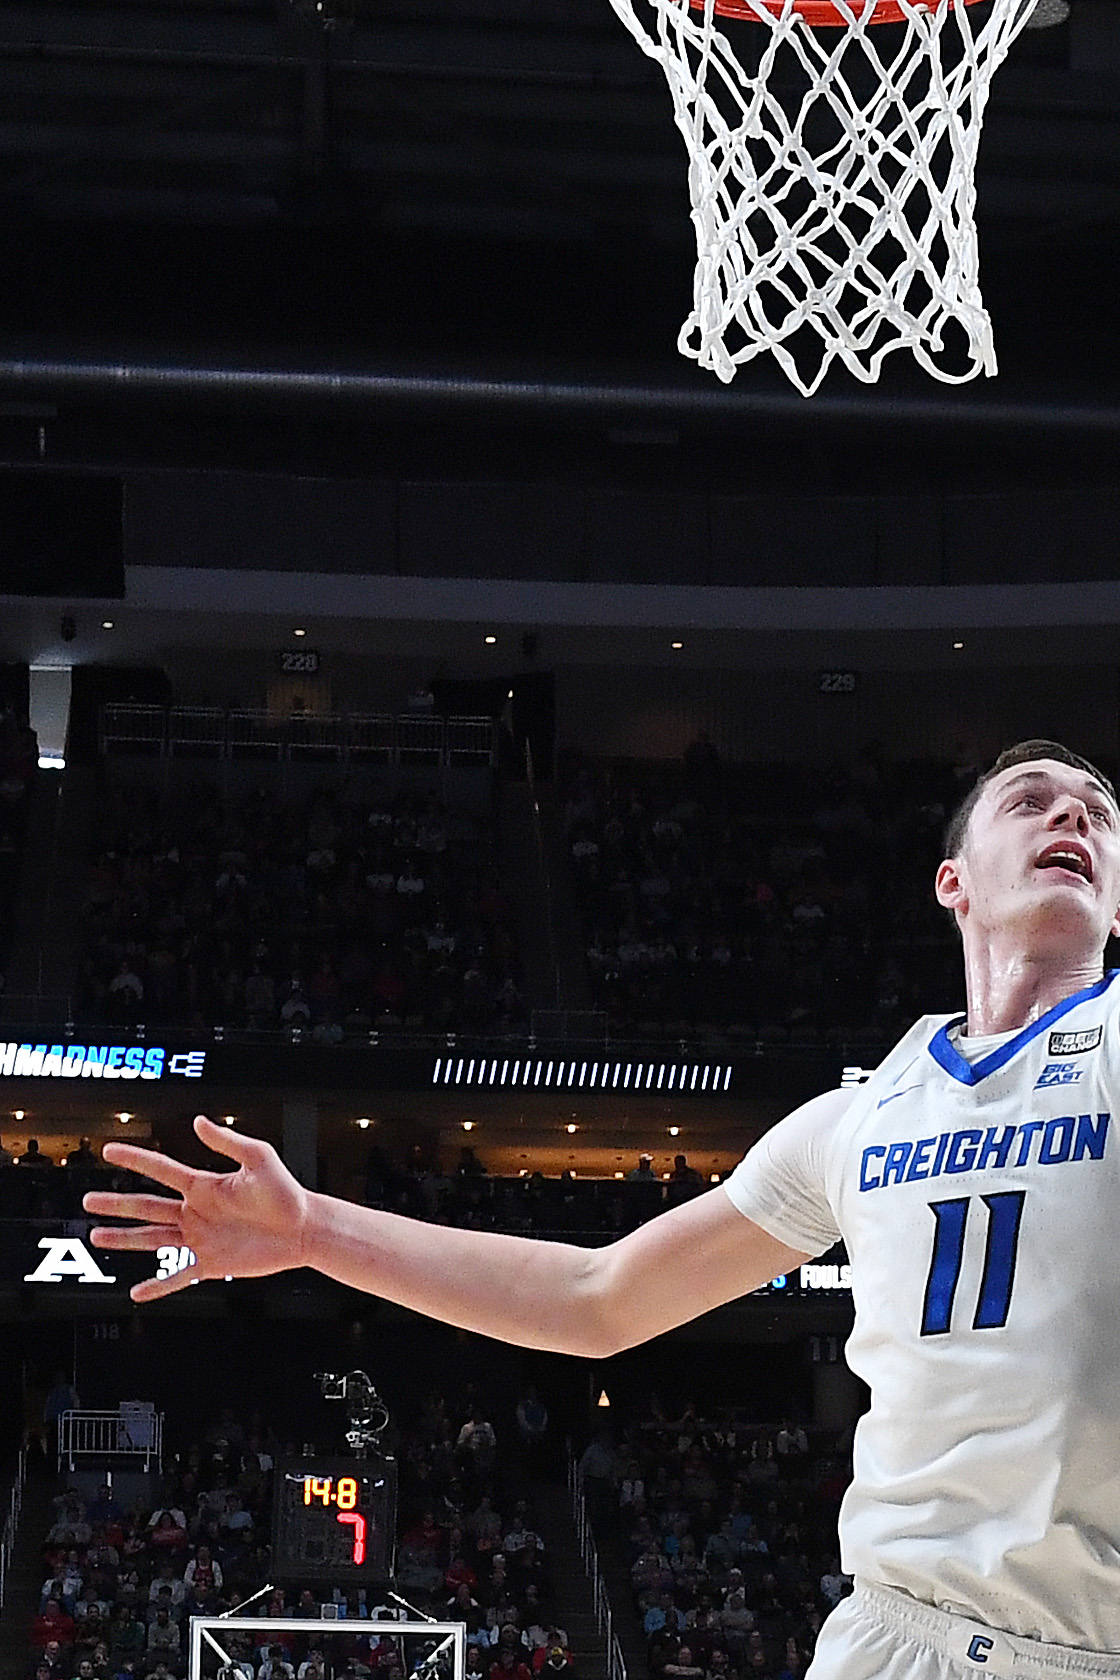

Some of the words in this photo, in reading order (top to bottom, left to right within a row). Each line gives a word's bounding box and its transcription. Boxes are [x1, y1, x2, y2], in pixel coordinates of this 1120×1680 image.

[1037, 1071, 1084, 1084] EAST
[1042, 1062, 1078, 1074] BIG
[858, 1112, 1111, 1192] CREIGHTON
[23, 1237, 116, 1283] A
[919, 1189, 1027, 1337] 11
[800, 1264, 852, 1289] FOULS
[304, 1478, 357, 1509] 14.8
[336, 1512, 365, 1565] 7
[966, 1634, 995, 1663] C
